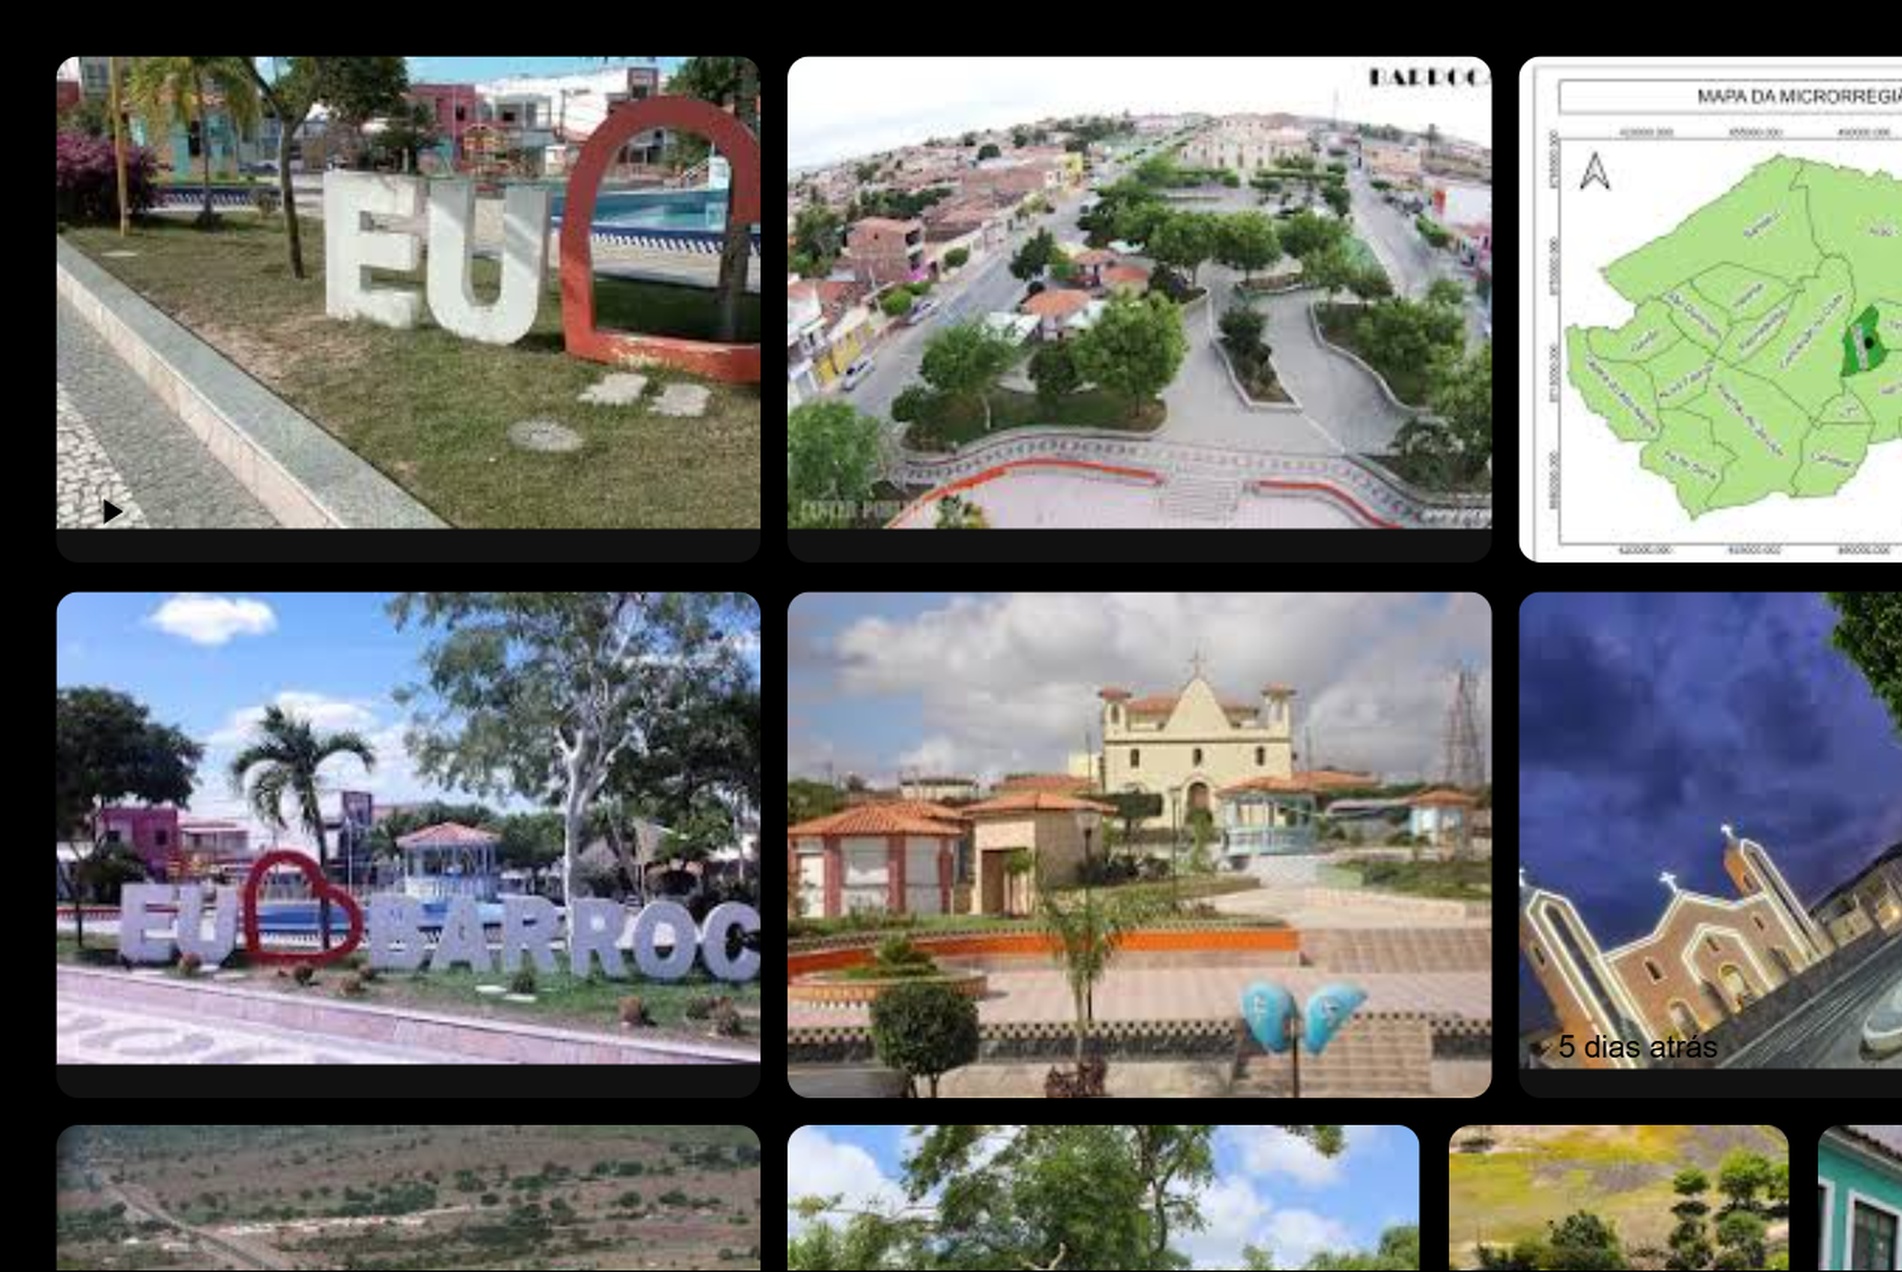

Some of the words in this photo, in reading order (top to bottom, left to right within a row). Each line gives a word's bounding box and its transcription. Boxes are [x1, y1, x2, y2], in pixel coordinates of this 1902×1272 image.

[1698, 89, 1747, 104] MAPA
[1752, 89, 1776, 104] DA
[323, 170, 550, 346] EU
[118, 883, 238, 963] EU
